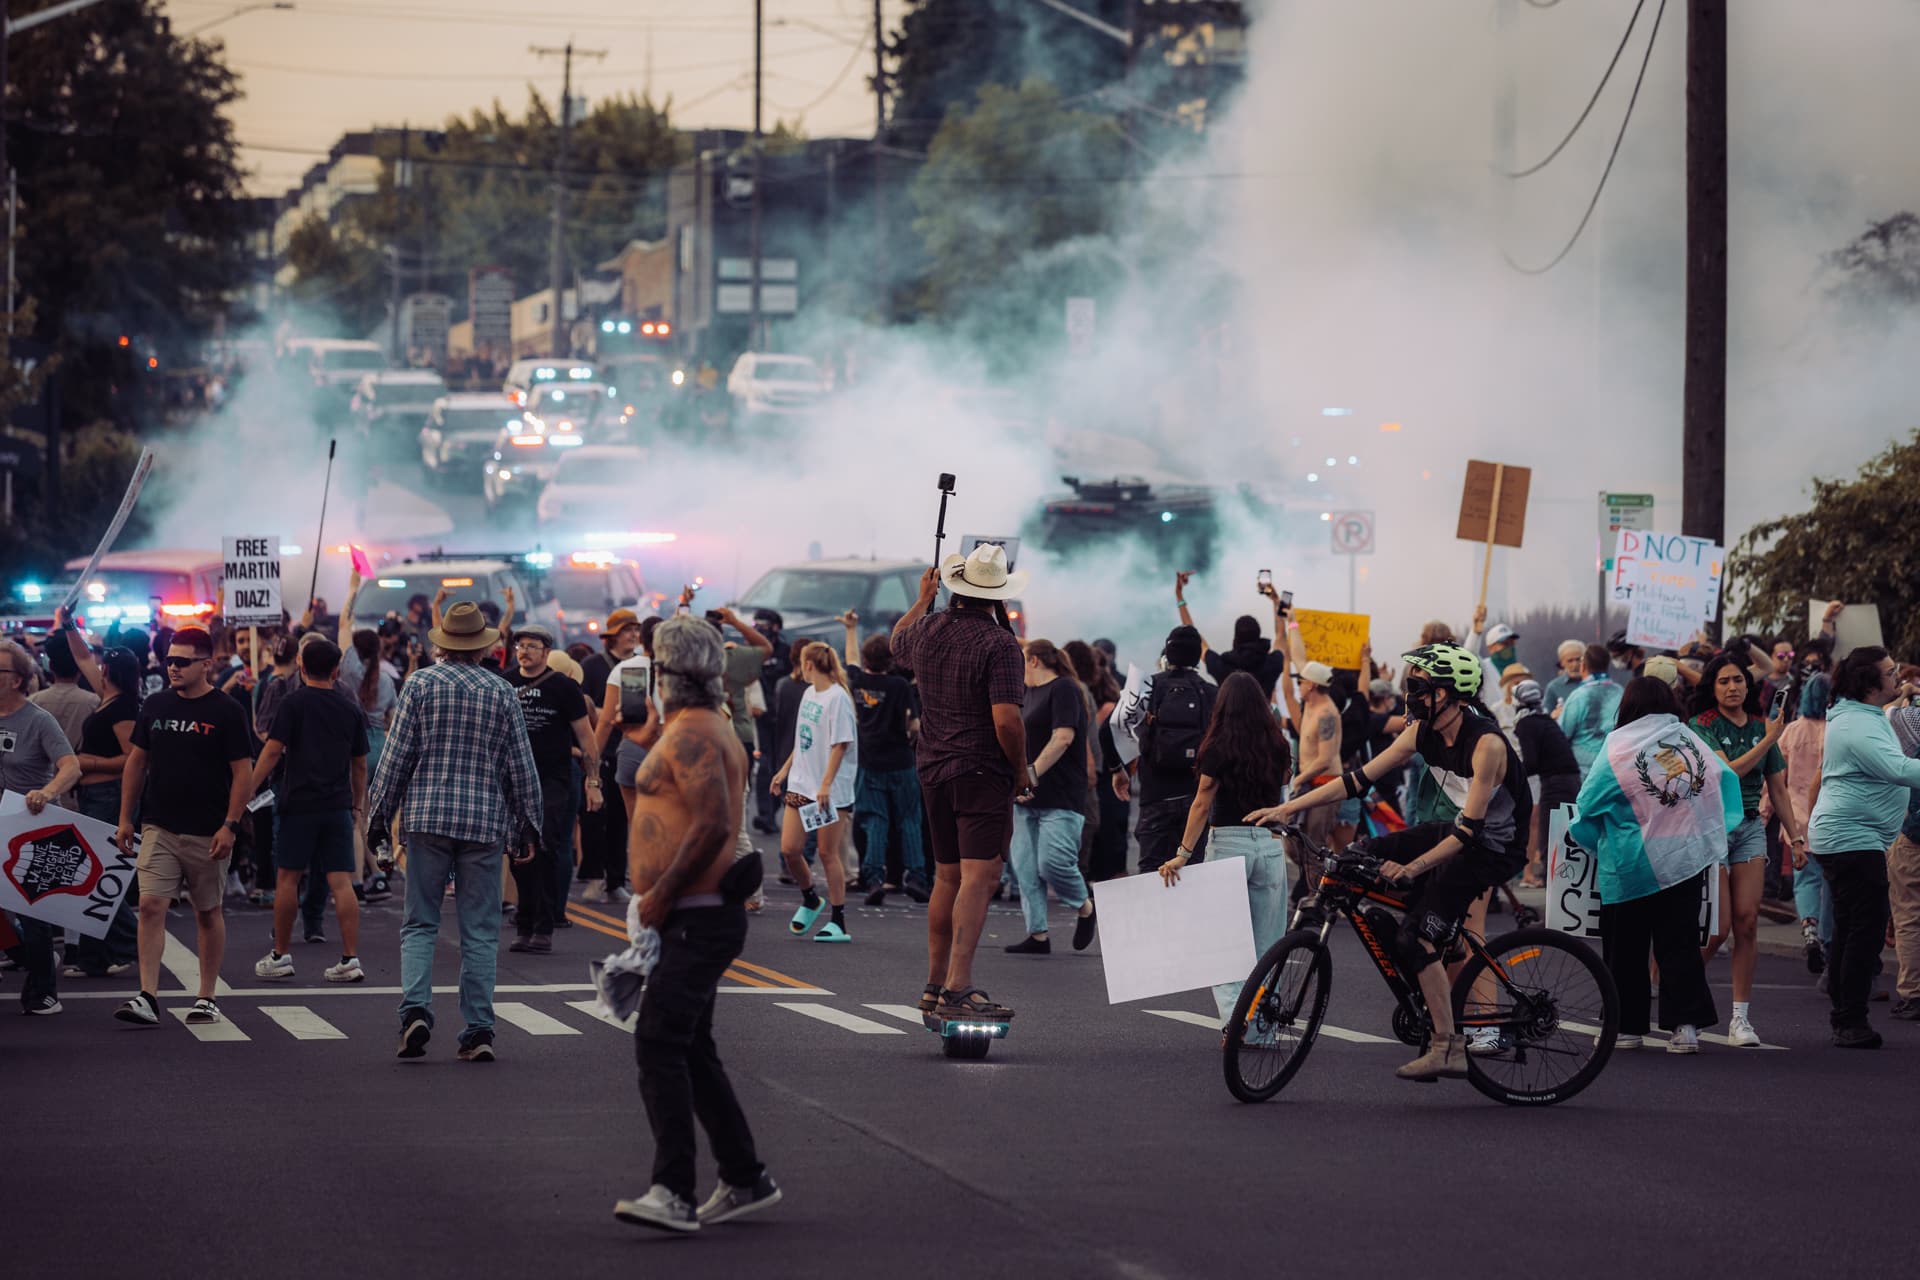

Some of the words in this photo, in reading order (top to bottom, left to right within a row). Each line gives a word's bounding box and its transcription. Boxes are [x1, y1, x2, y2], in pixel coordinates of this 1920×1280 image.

[236, 539, 268, 557] FREE
[1644, 534, 1710, 566] NOT
[225, 561, 280, 580] MARTIN
[235, 590, 270, 608] DIAZ!
[151, 719, 216, 735] ARIAT
[33, 843, 50, 868] HAVE
[43, 841, 62, 875] RIGHT
[49, 864, 64, 881] TO
[57, 848, 70, 865] BE
[59, 845, 82, 887] HEARD
[27, 866, 43, 884] WE
[36, 874, 52, 893] THE
[82, 836, 142, 922] NOW
[1350, 911, 1398, 977] ANCHEER
